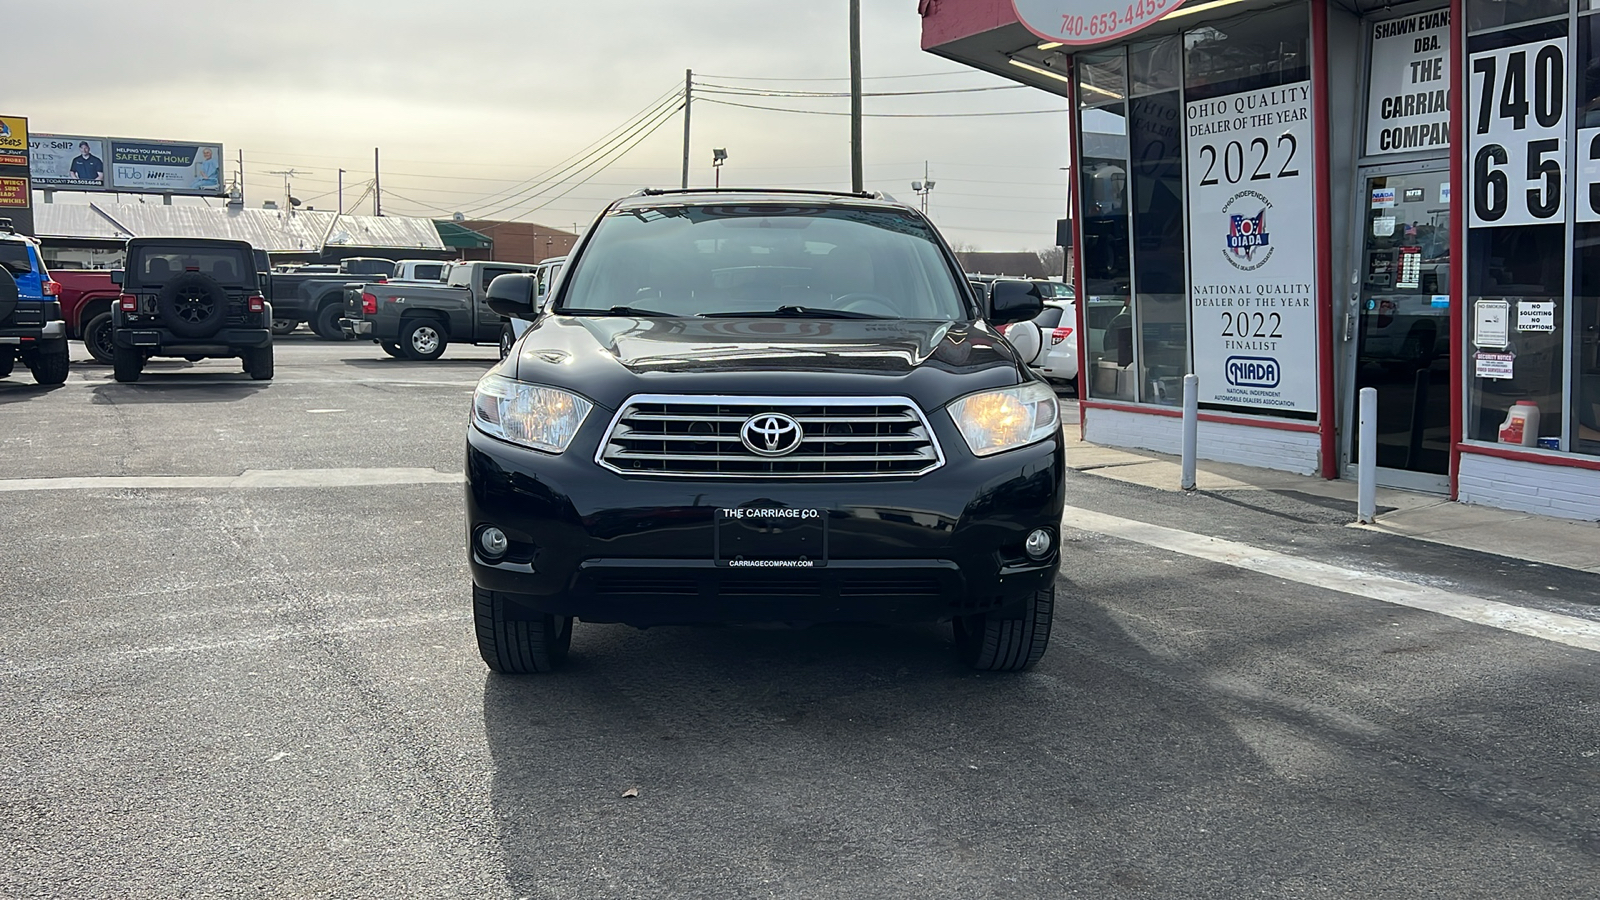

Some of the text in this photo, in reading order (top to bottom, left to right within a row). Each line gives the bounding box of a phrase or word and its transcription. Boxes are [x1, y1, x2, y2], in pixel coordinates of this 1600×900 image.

[1375, 18, 1416, 40] SHAWN
[1414, 35, 1441, 53] DBA.
[1410, 58, 1443, 84] THE
[1473, 44, 1564, 135] 740
[1188, 85, 1309, 119] OHIO QUALITY
[1190, 107, 1308, 137] DEALER OF THE YEAR
[51, 141, 73, 149] Sell?
[115, 153, 148, 161] SAFELY
[164, 156, 190, 164] HOME
[1199, 133, 1299, 187] 2022
[118, 167, 142, 179] Hub
[1222, 190, 1273, 214] OHIO INDEPENDENT
[1231, 234, 1262, 246] OIADA
[1194, 284, 1311, 295] NATIONAL QUALITY
[1195, 298, 1310, 307] DEALER OF THE YEAR
[1221, 311, 1283, 338] 2022
[1225, 341, 1277, 351] FINALIST
[1230, 362, 1275, 384] NIADA
[1263, 399, 1295, 407] ASSOCIATION
[723, 508, 820, 518] THE CARRIAGE CO.
